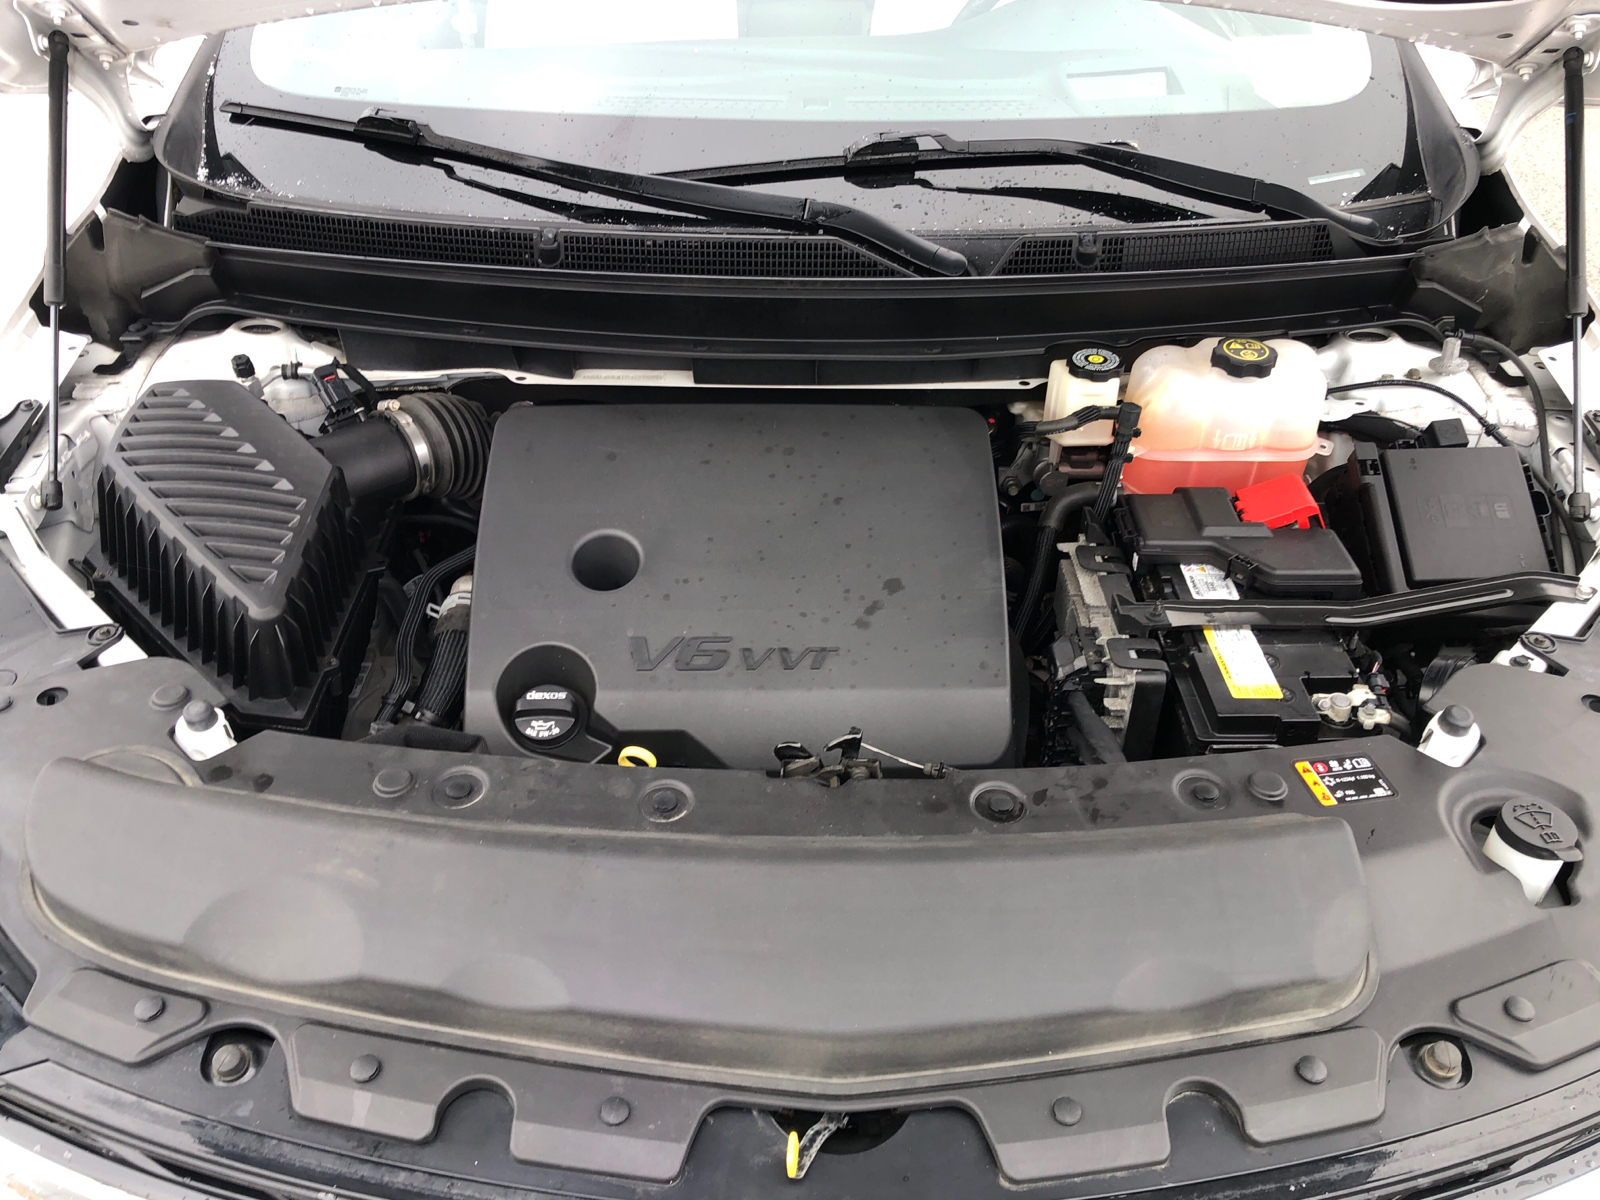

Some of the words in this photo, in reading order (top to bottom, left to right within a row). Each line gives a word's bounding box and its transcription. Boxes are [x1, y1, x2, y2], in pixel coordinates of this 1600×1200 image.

[629, 636, 734, 671] V6
[739, 647, 840, 670] VVT
[526, 690, 568, 700] dexos
